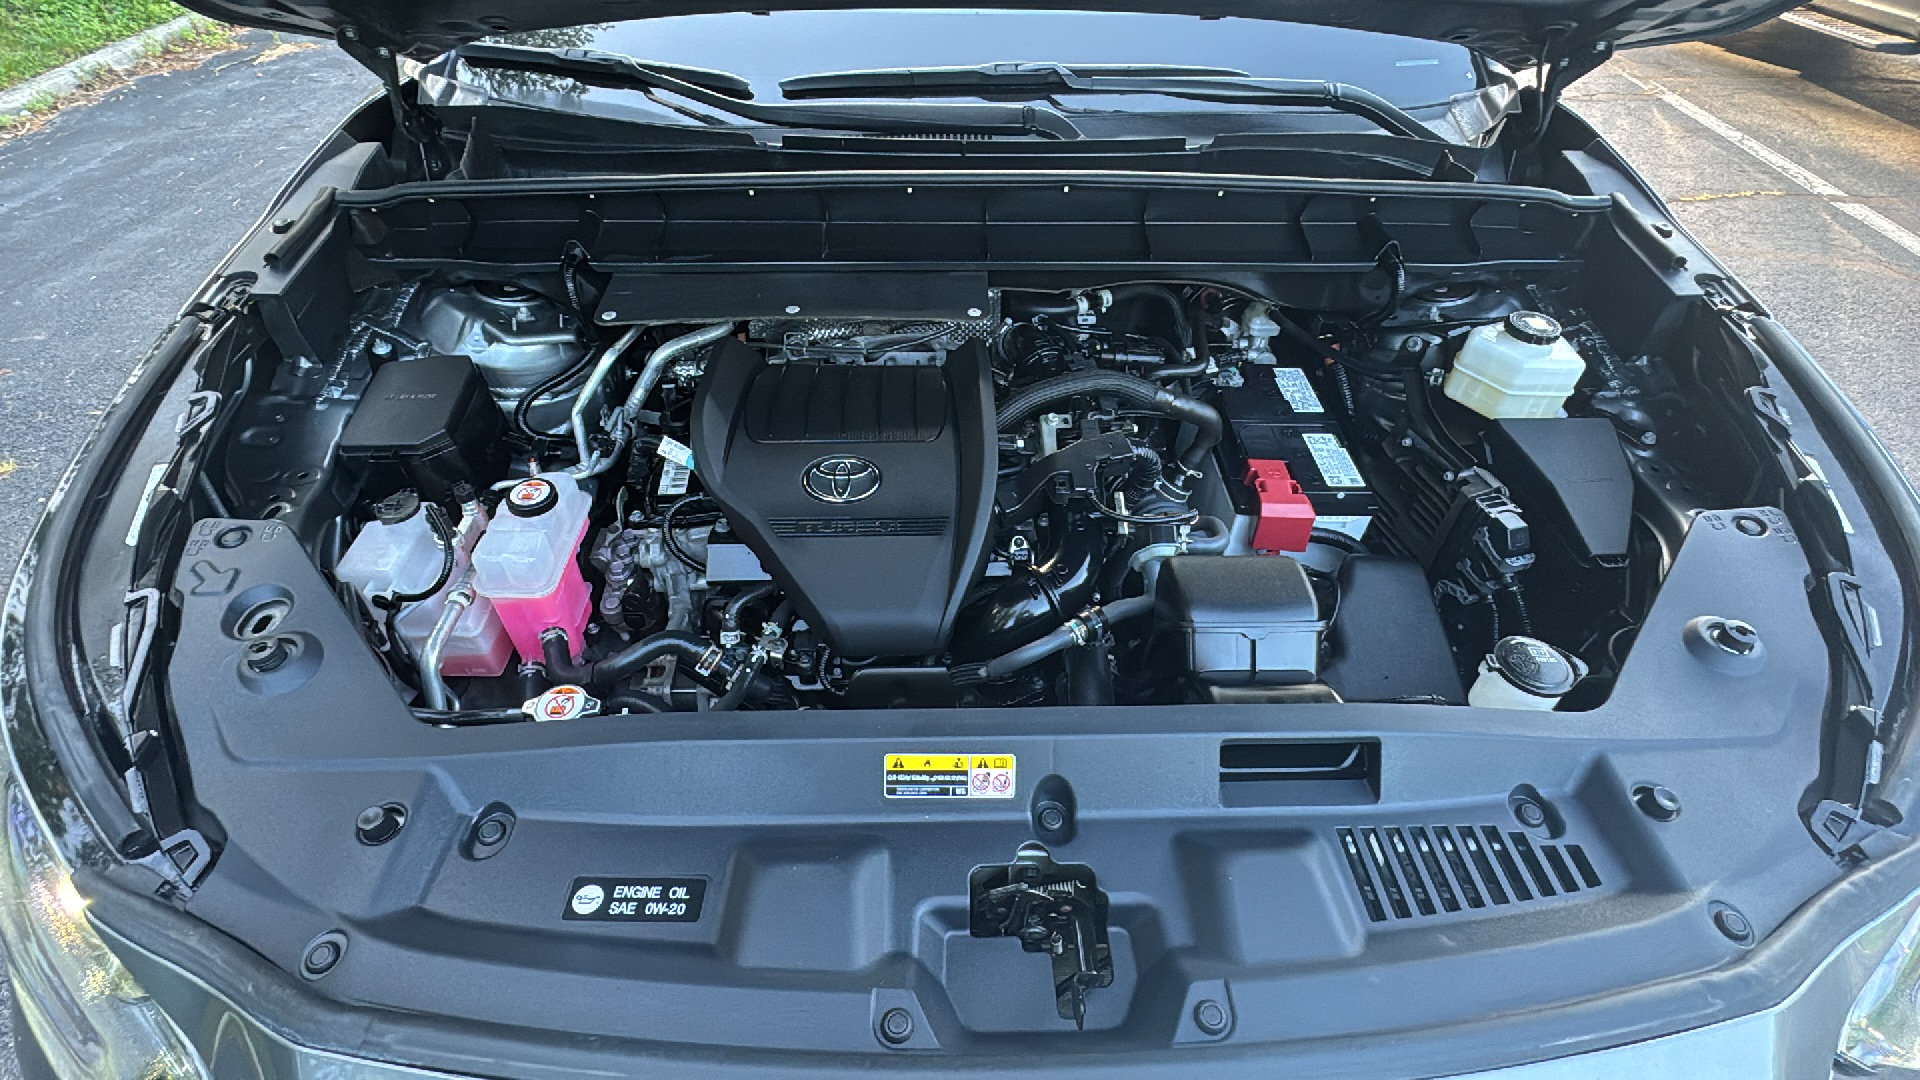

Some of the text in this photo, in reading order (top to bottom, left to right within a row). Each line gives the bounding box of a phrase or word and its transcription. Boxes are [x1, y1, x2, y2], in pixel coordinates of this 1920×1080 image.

[613, 885, 691, 899] ENGINE OIL
[608, 901, 687, 915] SAE 0W-20
